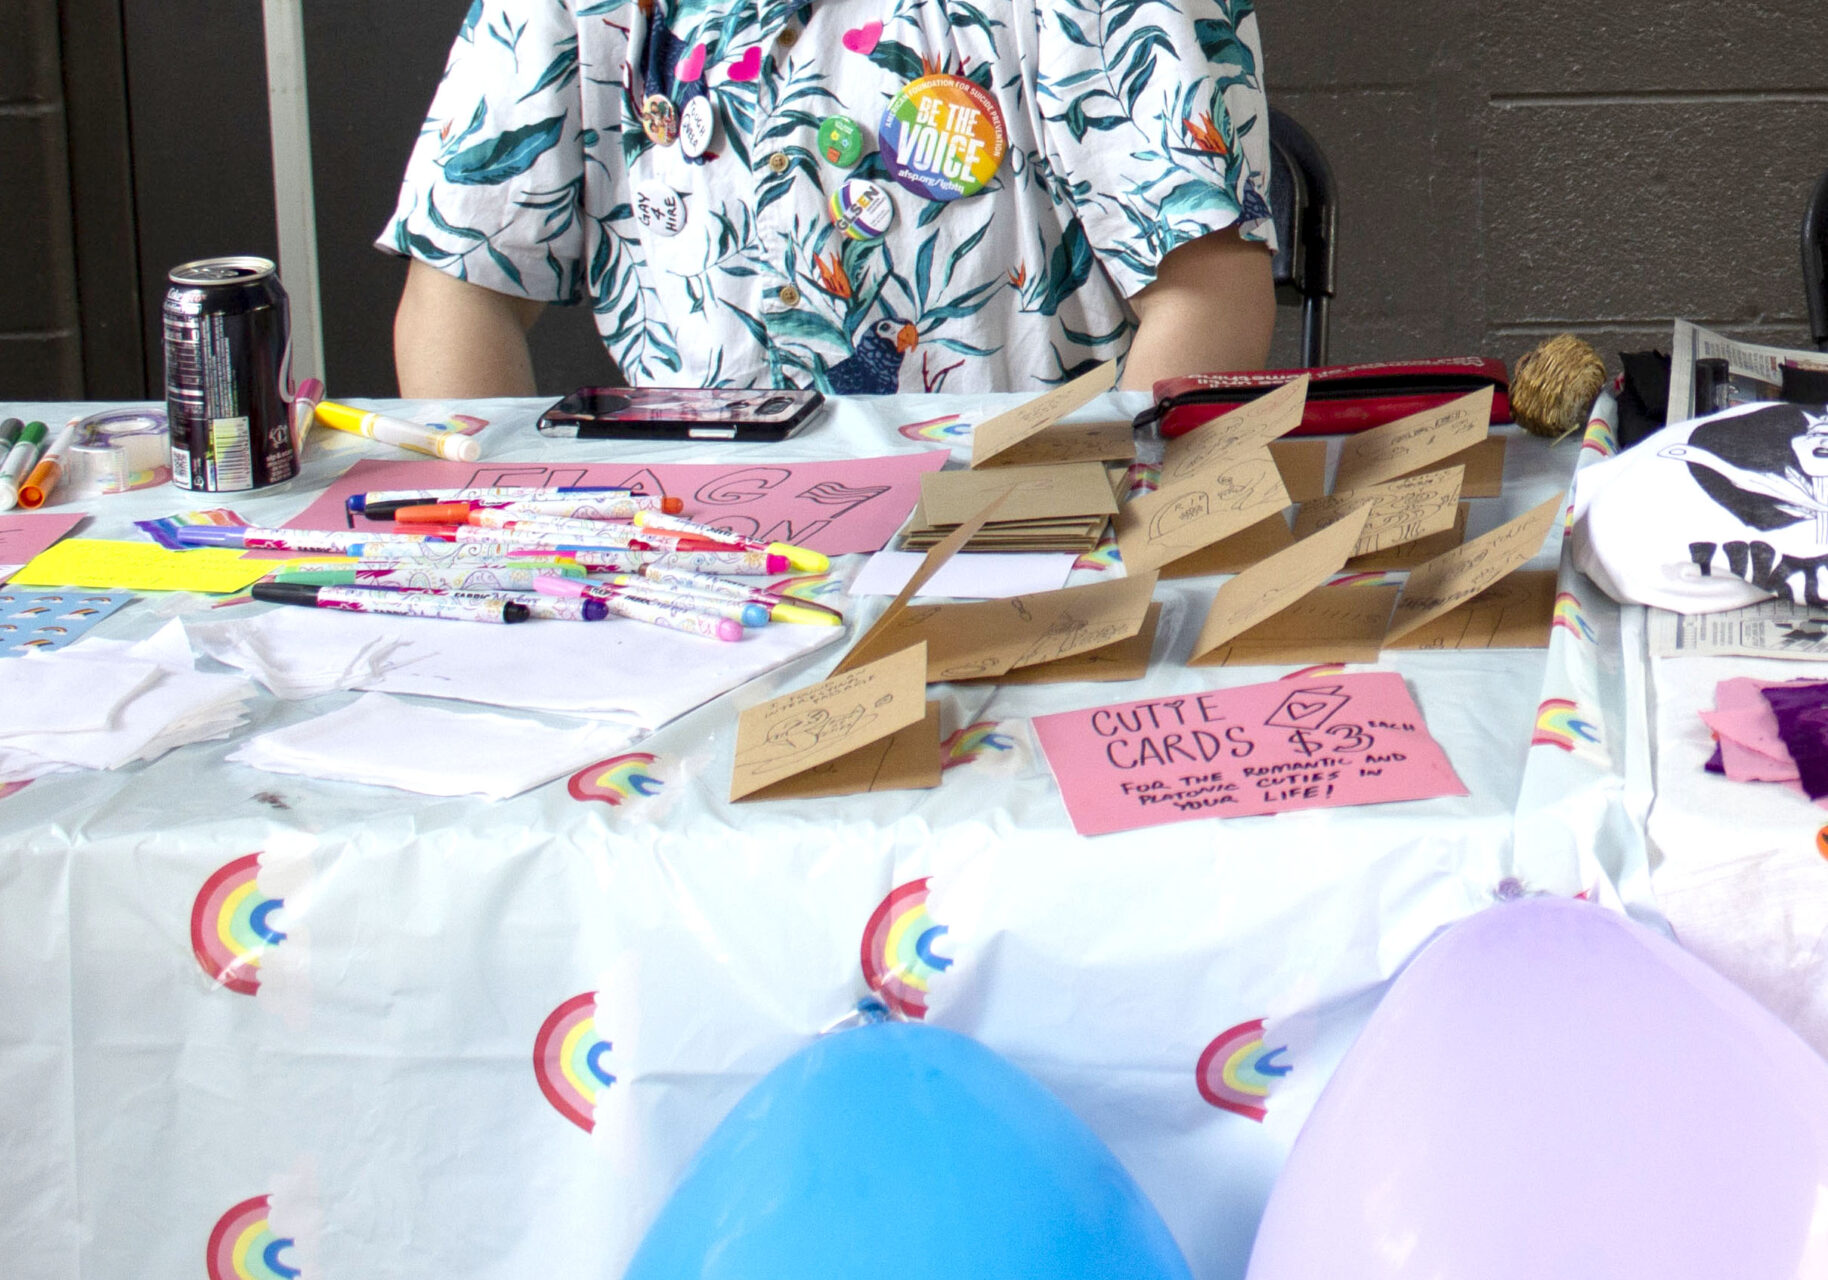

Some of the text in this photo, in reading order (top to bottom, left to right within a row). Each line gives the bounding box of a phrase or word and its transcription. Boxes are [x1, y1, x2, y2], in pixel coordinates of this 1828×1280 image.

[907, 78, 954, 96] FOUNDATION
[955, 80, 971, 92] FOR
[970, 87, 994, 112] SUICIDE
[990, 108, 1004, 158] PREVENTION
[916, 95, 981, 137] BE THE
[896, 120, 986, 184] VOICE
[898, 168, 966, 195] afsp.org/lgbtq
[637, 191, 651, 227] GAY
[650, 206, 667, 222] 4
[664, 195, 678, 233] HIRE
[836, 185, 880, 231] GLSEN
[1091, 694, 1227, 738] CUTIE
[1106, 719, 1417, 771] CARDS $3 EACH
[1120, 752, 1408, 797] FOR THE ROMANTIC AND
[1138, 767, 1382, 806] PLATONIC CUTIES IN
[1173, 783, 1336, 811] YOUR LIFE!
